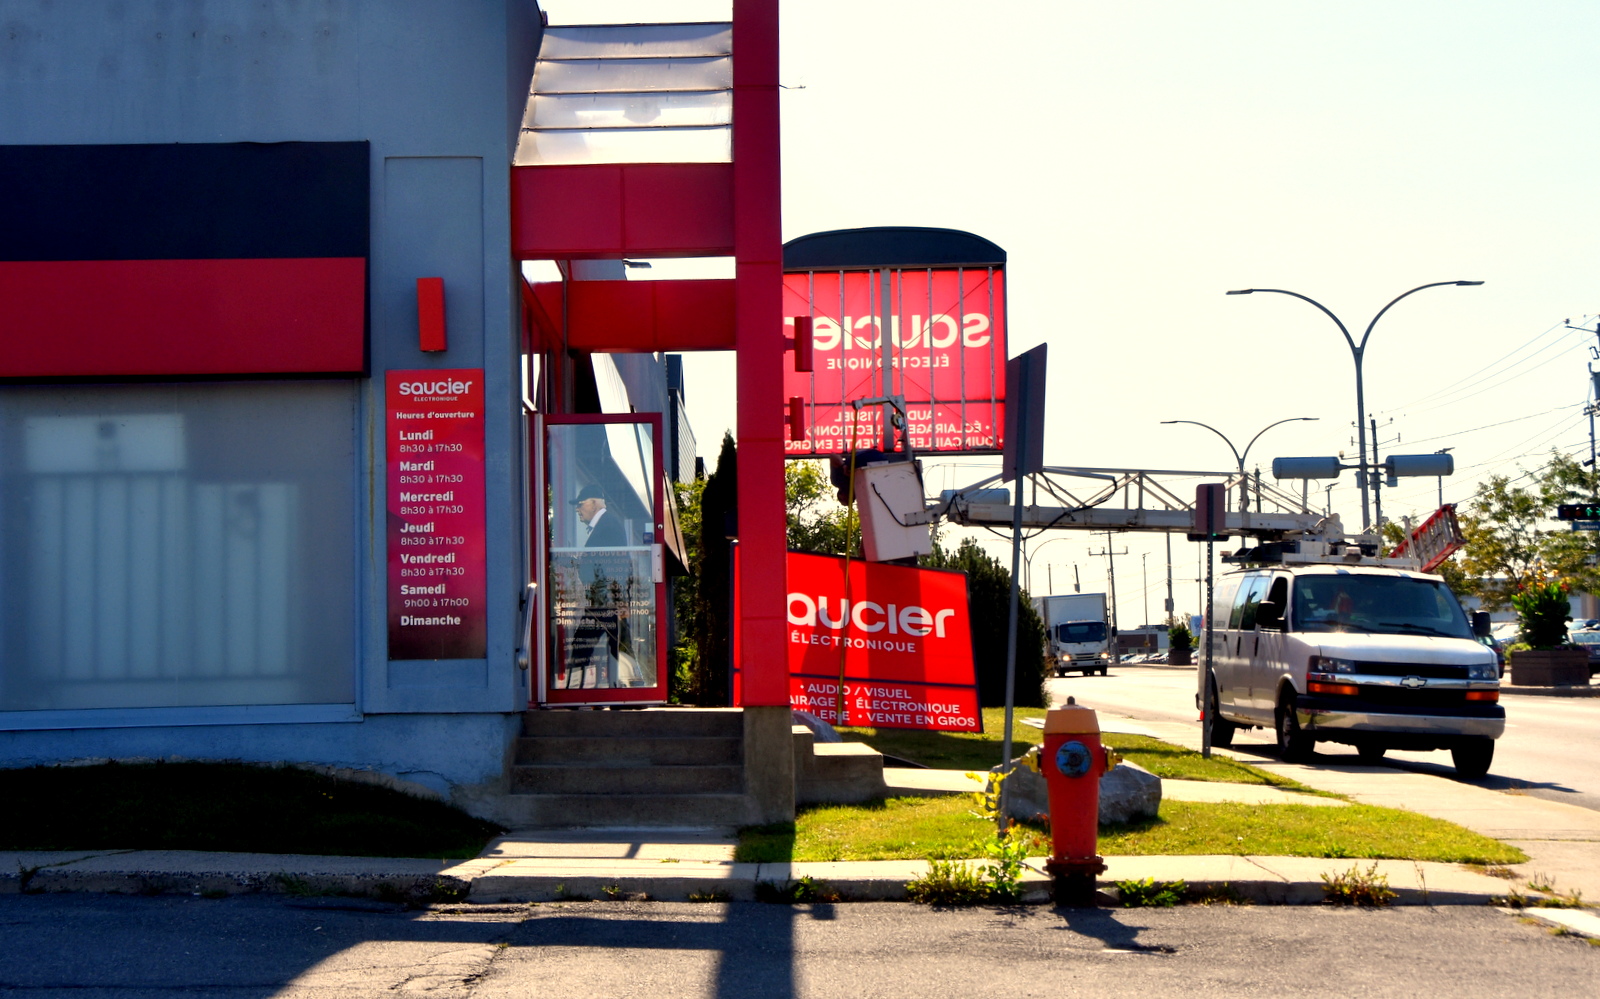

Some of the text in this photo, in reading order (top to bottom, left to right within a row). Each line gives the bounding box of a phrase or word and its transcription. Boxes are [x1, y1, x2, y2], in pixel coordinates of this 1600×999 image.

[399, 378, 473, 395] saucier
[427, 411, 475, 419] d'ouverture
[399, 429, 434, 441] Lundi
[400, 443, 463, 453] 8h30 à 17h30
[400, 460, 434, 471] Mardi
[400, 474, 464, 483] 8h30 à 17h30
[400, 491, 454, 502] Mercredi
[400, 505, 464, 515] 8h30 à 17h30
[399, 522, 435, 533] Jeudi
[400, 537, 426, 545] 8h30
[428, 536, 434, 545] à
[400, 552, 455, 564] Vendredi
[400, 568, 426, 577] 8h30
[428, 567, 434, 576] à
[400, 583, 446, 595] Samedi
[404, 598, 469, 608] 9h00 à 17h00
[400, 615, 461, 626] Dimanche
[786, 592, 955, 638] aucier
[791, 630, 916, 653] ÉLECTRONIQUE
[863, 686, 912, 699] VISUEL
[855, 697, 961, 714] ÉLECTRONIQUE
[866, 712, 976, 727] VENTE EN GROS
